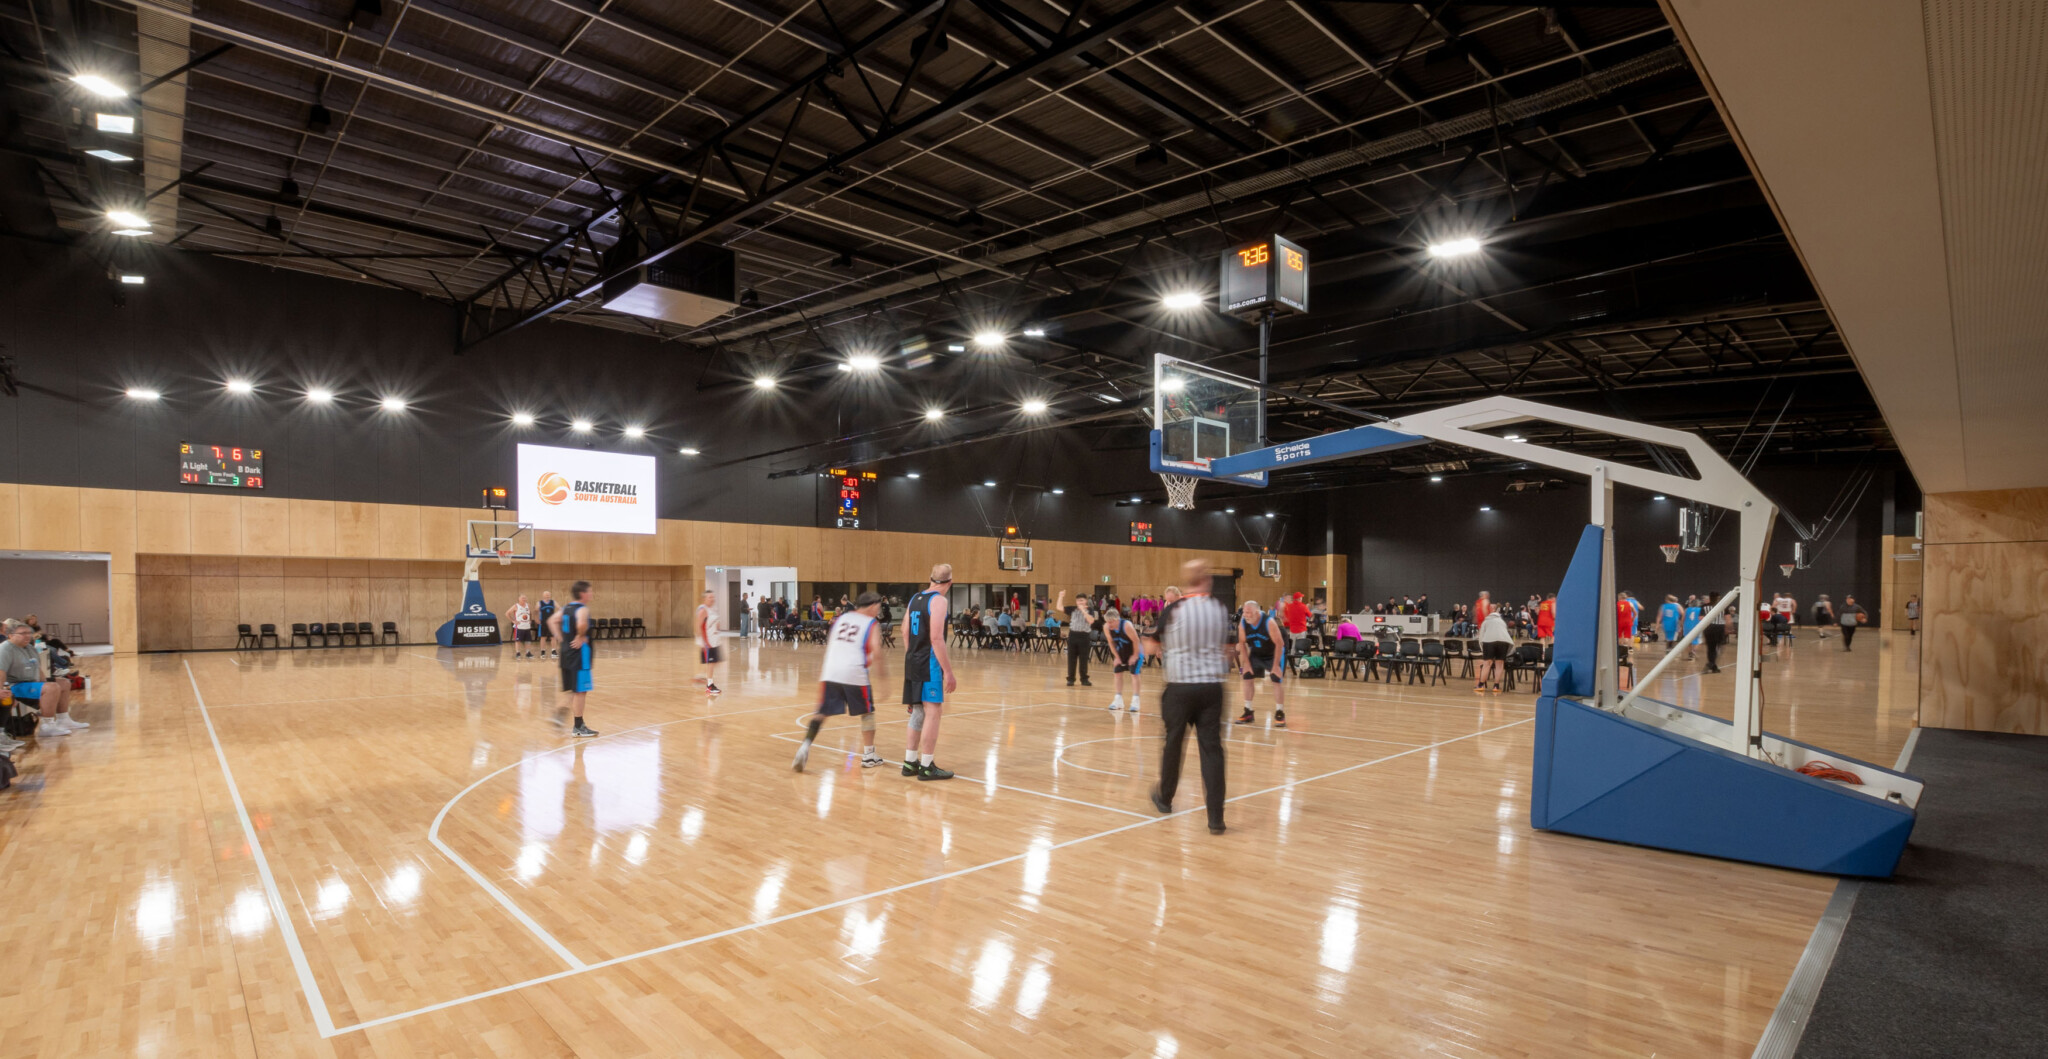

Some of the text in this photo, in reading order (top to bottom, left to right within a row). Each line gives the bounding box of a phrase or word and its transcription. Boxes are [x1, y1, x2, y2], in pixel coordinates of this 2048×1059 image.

[1238, 244, 1268, 267] 7:36
[1228, 296, 1266, 310] esa.com.au
[1274, 443, 1310, 455] Schelde
[1275, 449, 1312, 462] Sports
[182, 462, 208, 471] A Light
[238, 465, 261, 474] B Dark
[232, 476, 239, 486] 3
[246, 476, 262, 487] 27
[574, 480, 637, 496] BASKETBALL
[574, 493, 638, 505] SOUTH AUSTRALIA
[850, 490, 859, 500] 24
[845, 499, 851, 508] 2
[839, 506, 844, 515] 2
[852, 507, 858, 516] 2
[854, 519, 859, 528] 2
[457, 625, 495, 634] BIG SHED
[837, 622, 860, 643] 22
